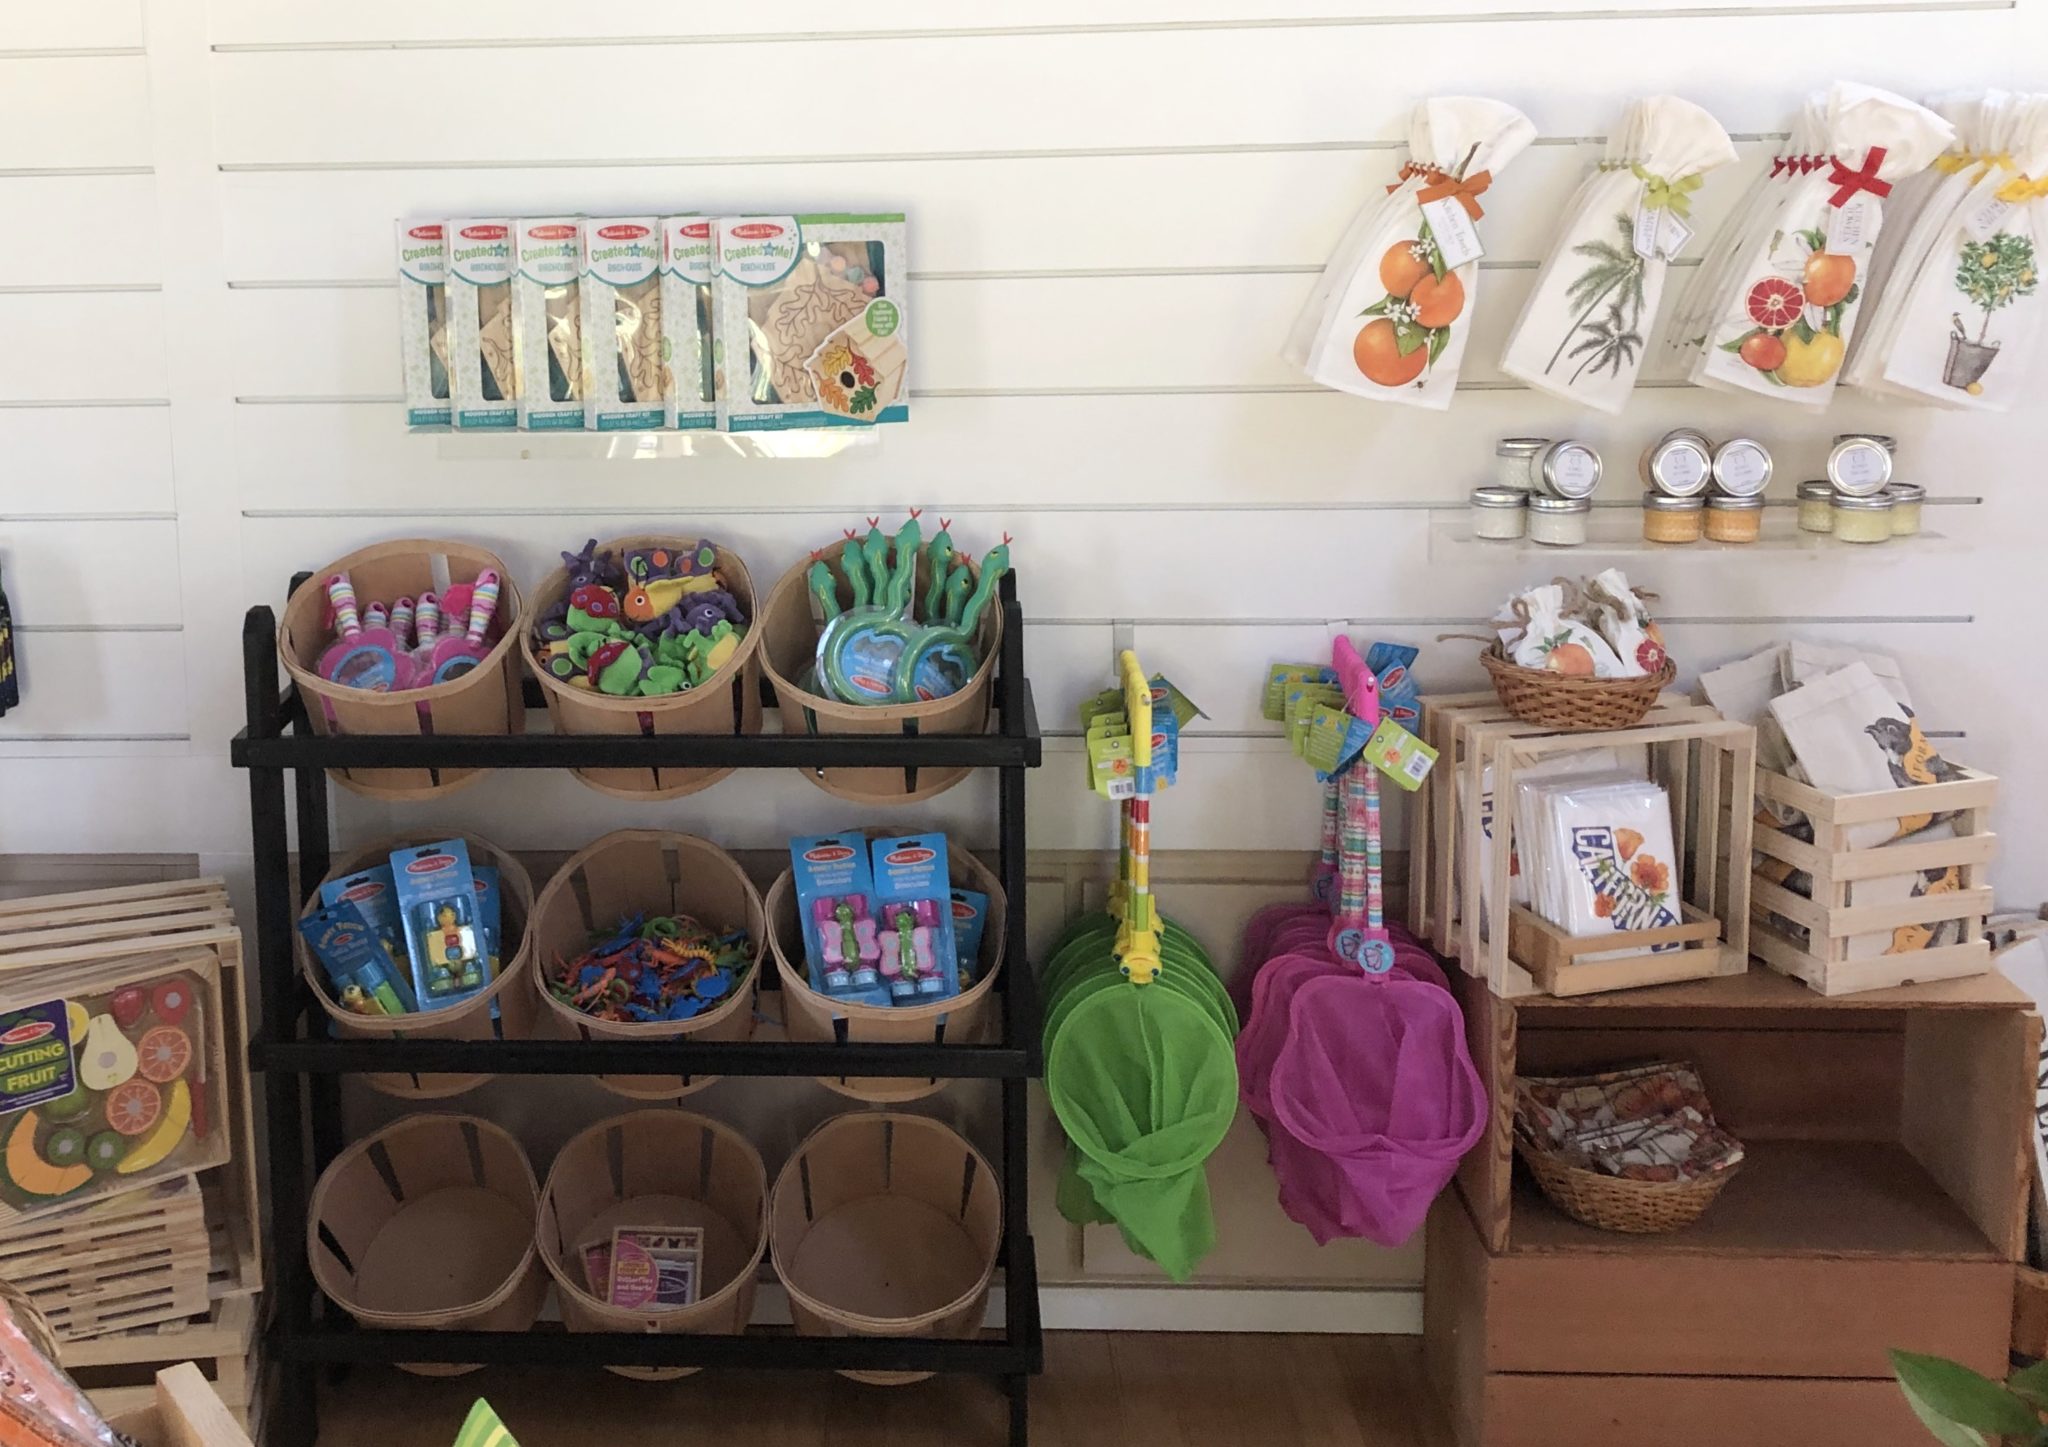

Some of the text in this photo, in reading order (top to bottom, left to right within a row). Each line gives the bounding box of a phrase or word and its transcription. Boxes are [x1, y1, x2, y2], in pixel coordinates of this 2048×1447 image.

[402, 244, 443, 262] Created
[454, 244, 494, 262] Created
[522, 244, 561, 262] Created
[592, 244, 630, 262] Created
[673, 243, 710, 261] Created
[724, 243, 794, 262] Created Me!
[0, 1042, 65, 1072] CUTTING
[6, 1066, 56, 1092] FRUIT
